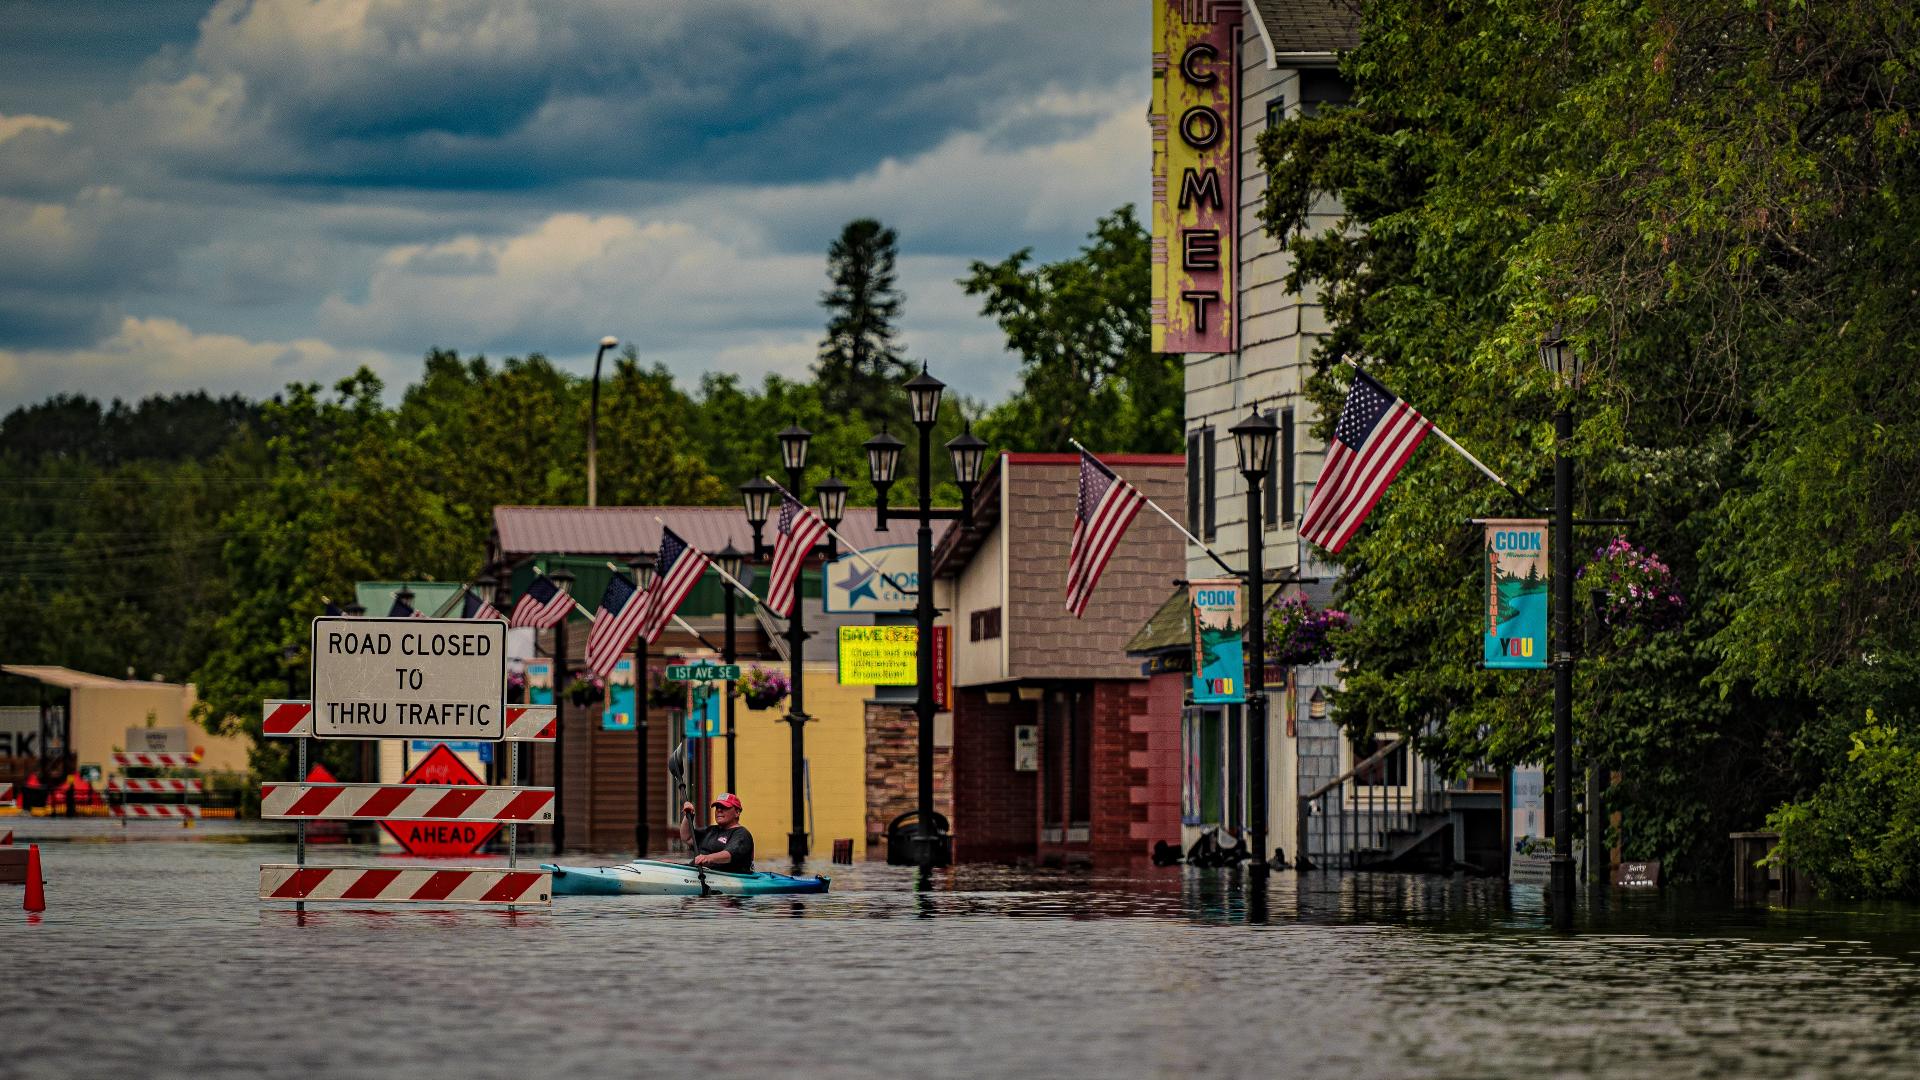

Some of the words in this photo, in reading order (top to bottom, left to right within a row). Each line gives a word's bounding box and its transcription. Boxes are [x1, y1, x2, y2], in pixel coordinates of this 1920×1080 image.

[1177, 41, 1224, 334] COMET
[1495, 530, 1541, 551] COOK
[1197, 590, 1235, 606] COOK
[1489, 552, 1499, 637] WELCOMES
[328, 632, 391, 655] ROAD
[401, 633, 491, 656] CLOSED
[1500, 637, 1533, 658] YOU
[395, 668, 423, 690] TO
[675, 667, 691, 679] 1ST
[694, 667, 714, 679] AVE
[718, 667, 732, 679] SE
[1205, 677, 1234, 695] YOU
[327, 702, 387, 724] THRU
[395, 703, 491, 726] TRAFFIC
[409, 826, 476, 844] AHEAD
